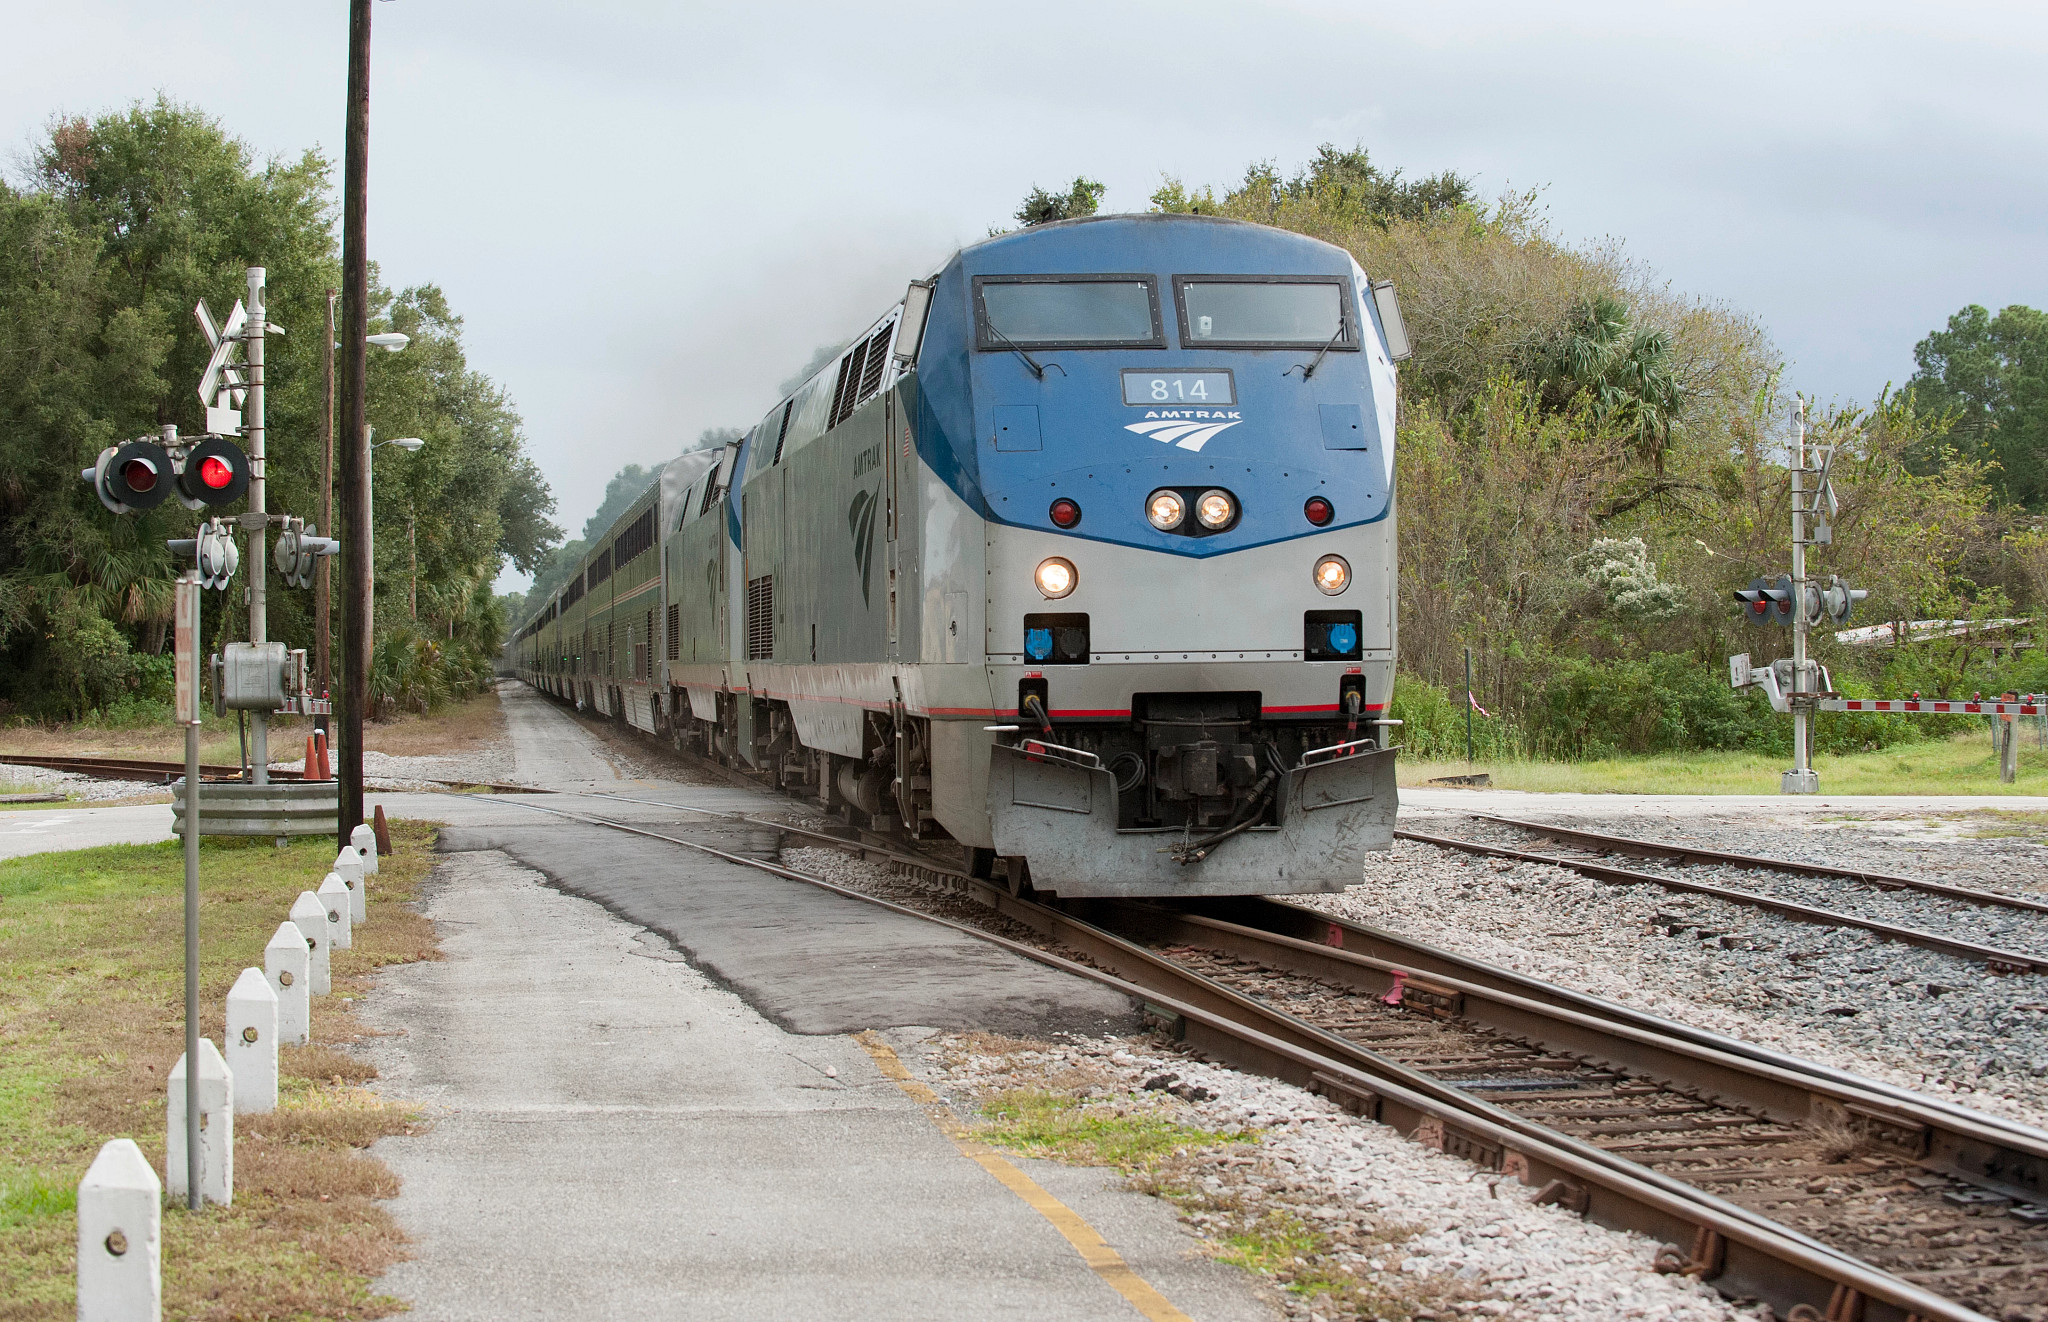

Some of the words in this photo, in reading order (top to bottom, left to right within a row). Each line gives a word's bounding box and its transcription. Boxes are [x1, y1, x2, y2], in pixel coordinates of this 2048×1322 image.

[1150, 379, 1209, 401] 814
[1144, 410, 1242, 420] AMTRAK
[853, 442, 881, 480] AMTRAK
